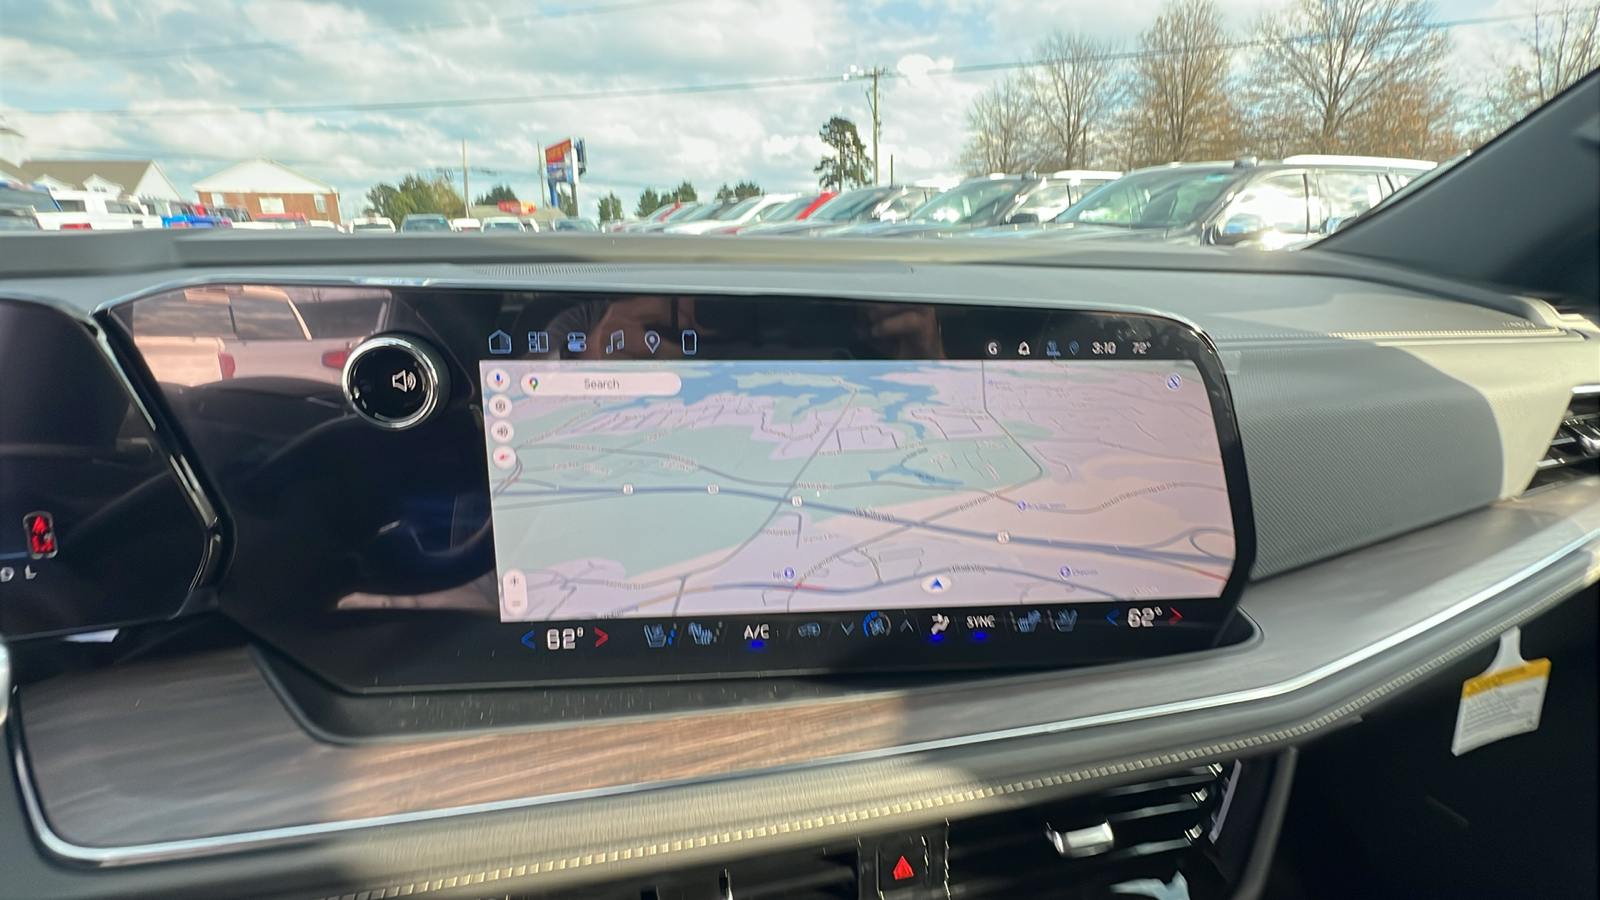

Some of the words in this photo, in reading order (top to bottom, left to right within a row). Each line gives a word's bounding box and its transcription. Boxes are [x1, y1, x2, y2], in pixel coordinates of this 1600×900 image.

[1092, 341, 1117, 355] 3:10
[584, 377, 620, 390] Search
[966, 614, 996, 629] SYNC
[743, 623, 770, 640] A/C
